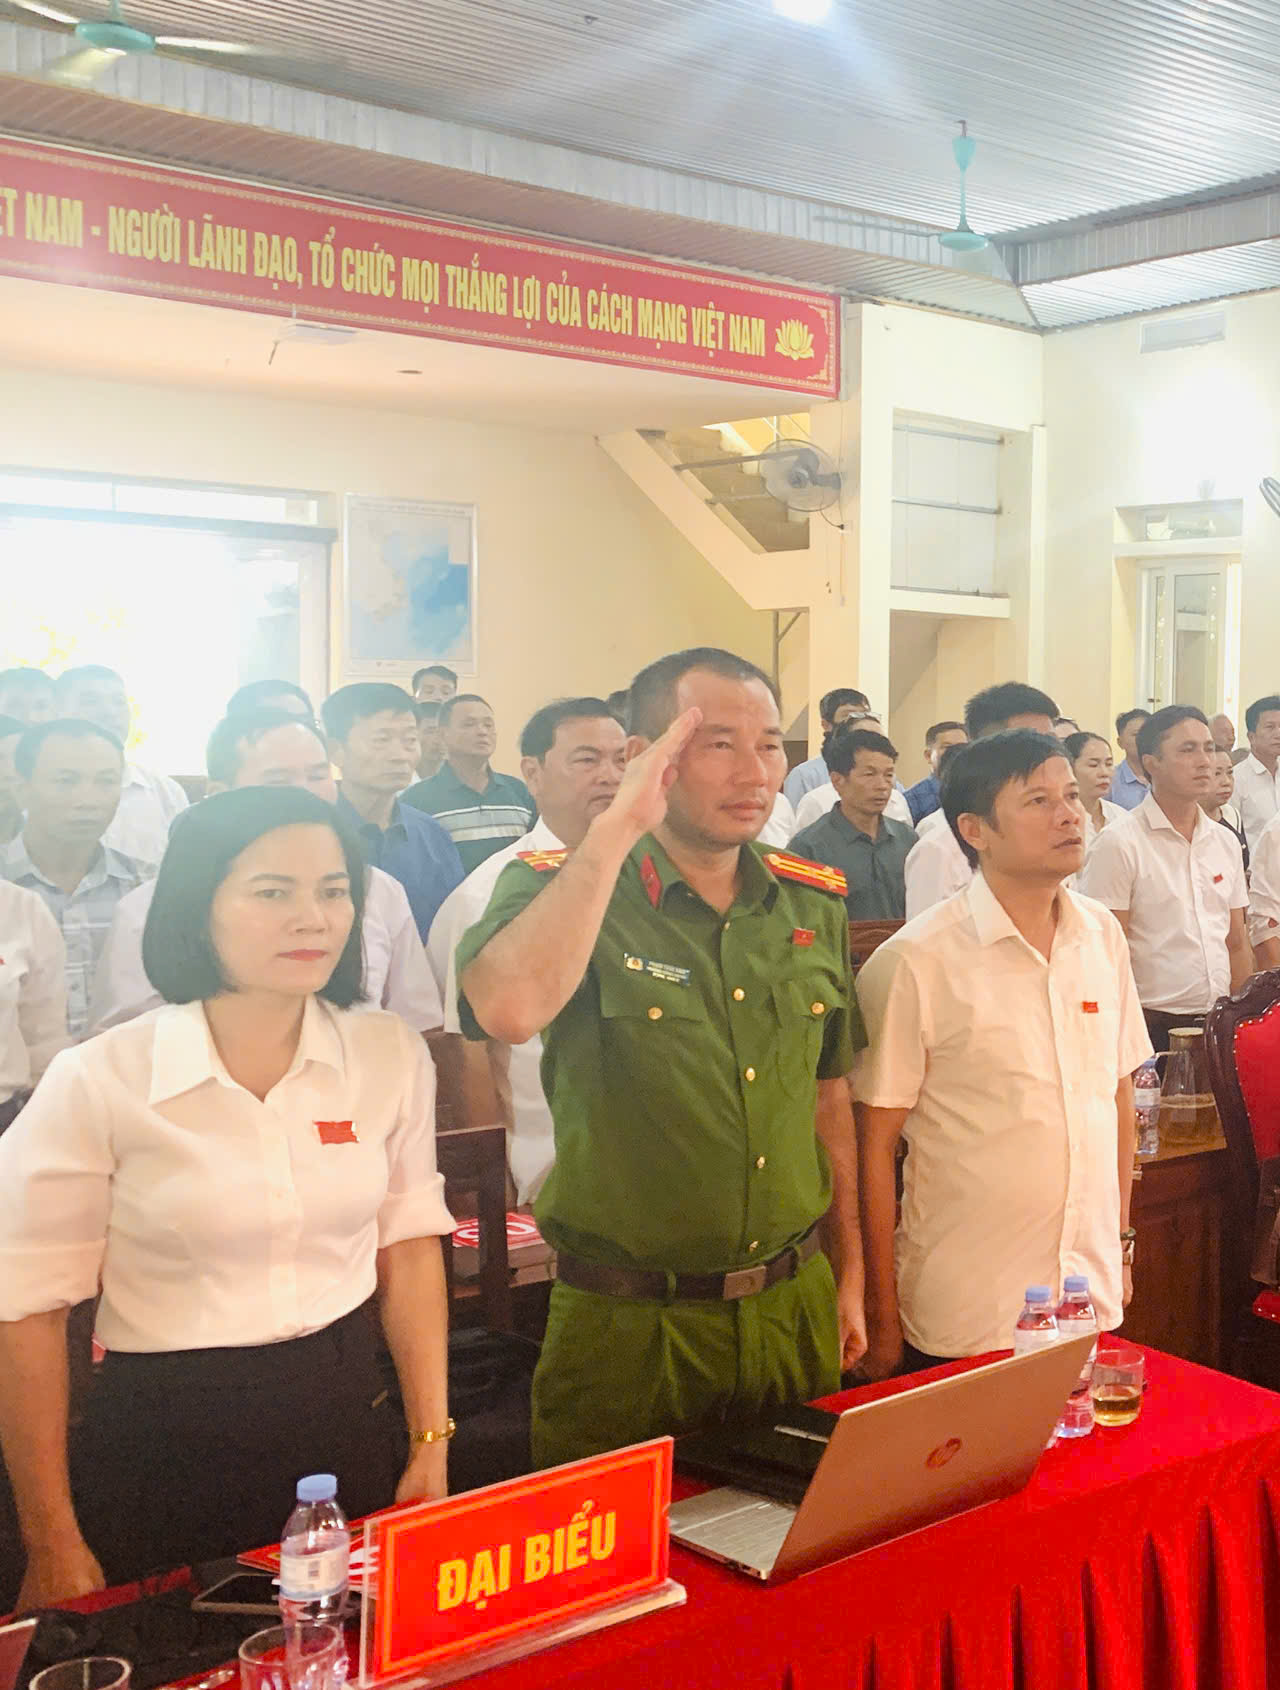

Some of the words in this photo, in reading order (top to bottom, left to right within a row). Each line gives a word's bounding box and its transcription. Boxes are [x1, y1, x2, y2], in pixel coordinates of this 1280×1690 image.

[25, 192, 83, 248] NAM
[108, 203, 181, 264] NGƯỜI
[188, 213, 246, 274] LÃNH
[254, 232, 302, 290] ĐẠO,
[309, 226, 335, 288] TỔ
[342, 242, 395, 297] CHỨC
[402, 257, 439, 314] MỌI
[446, 253, 507, 314] THẮNG
[513, 274, 540, 329] LỢI
[546, 269, 581, 328] CỦA
[587, 283, 633, 335] CÁCH
[638, 300, 687, 349] MẠNG
[692, 302, 724, 357] VIỆT
[729, 313, 765, 357] NAM
[437, 1544, 511, 1612] ĐẠI
[524, 1500, 616, 1584] BIỂU
